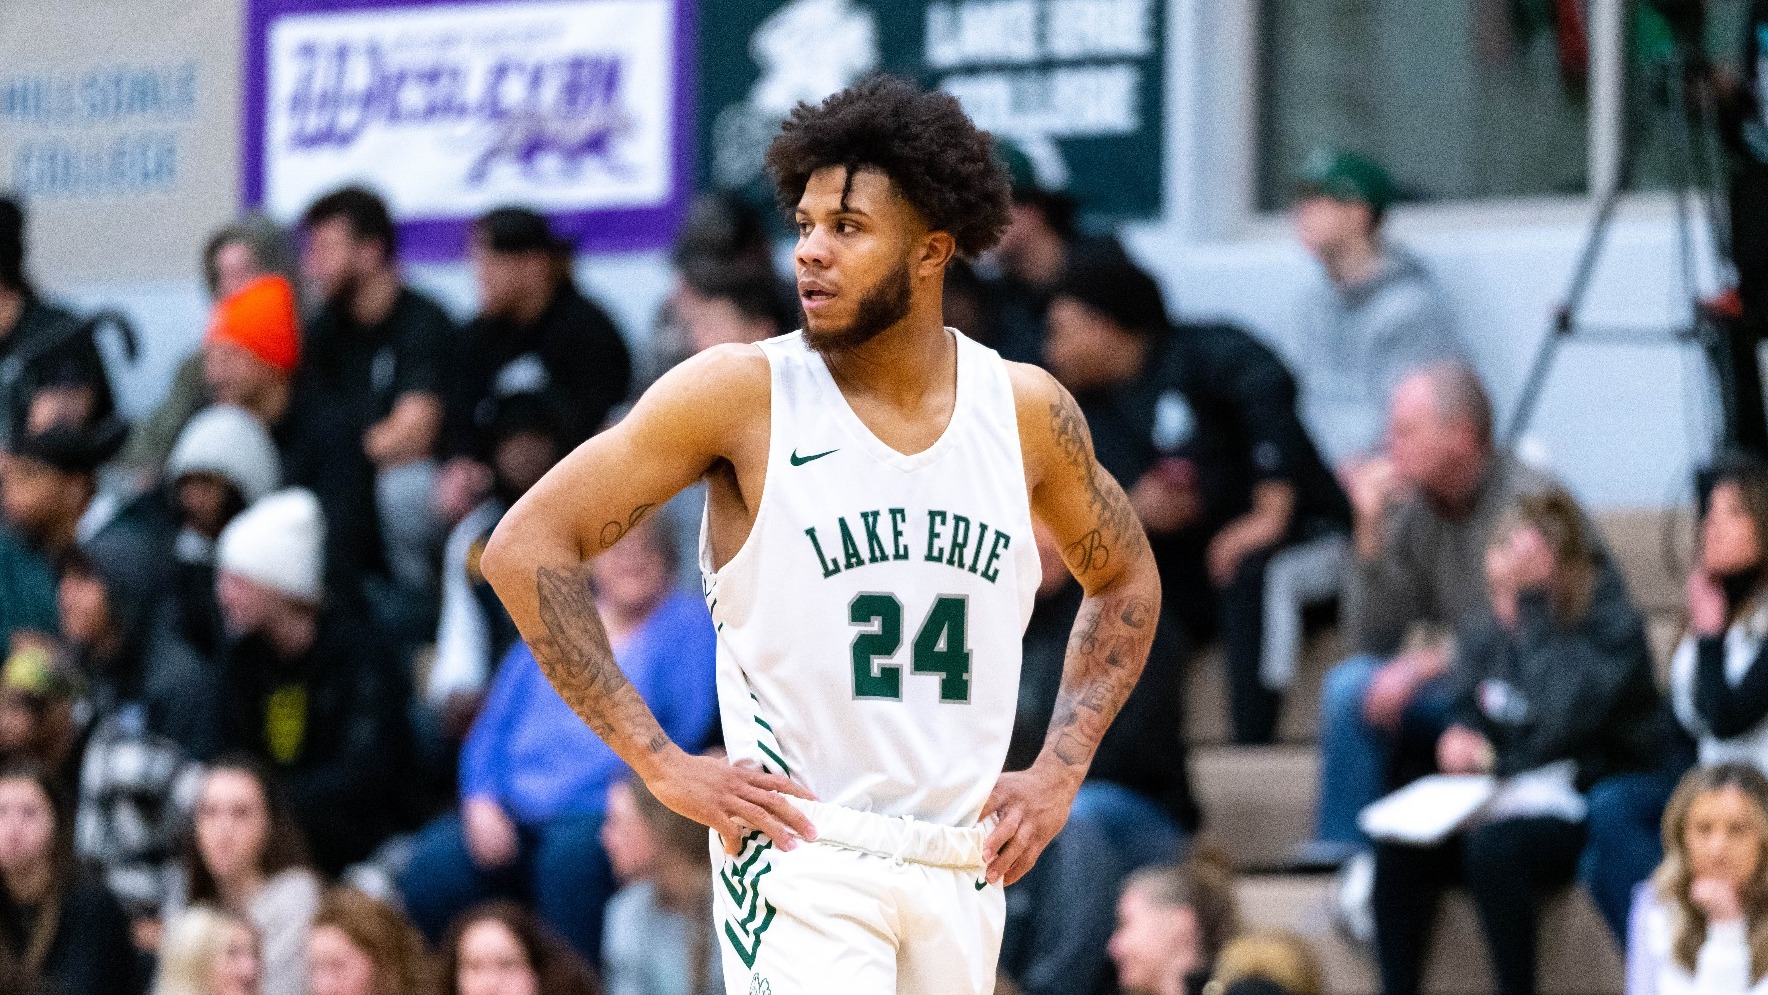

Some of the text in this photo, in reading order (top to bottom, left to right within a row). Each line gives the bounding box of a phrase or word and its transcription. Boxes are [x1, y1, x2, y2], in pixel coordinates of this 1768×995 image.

[804, 507, 1011, 584] LAKE ERIE
[847, 591, 973, 706] 24
